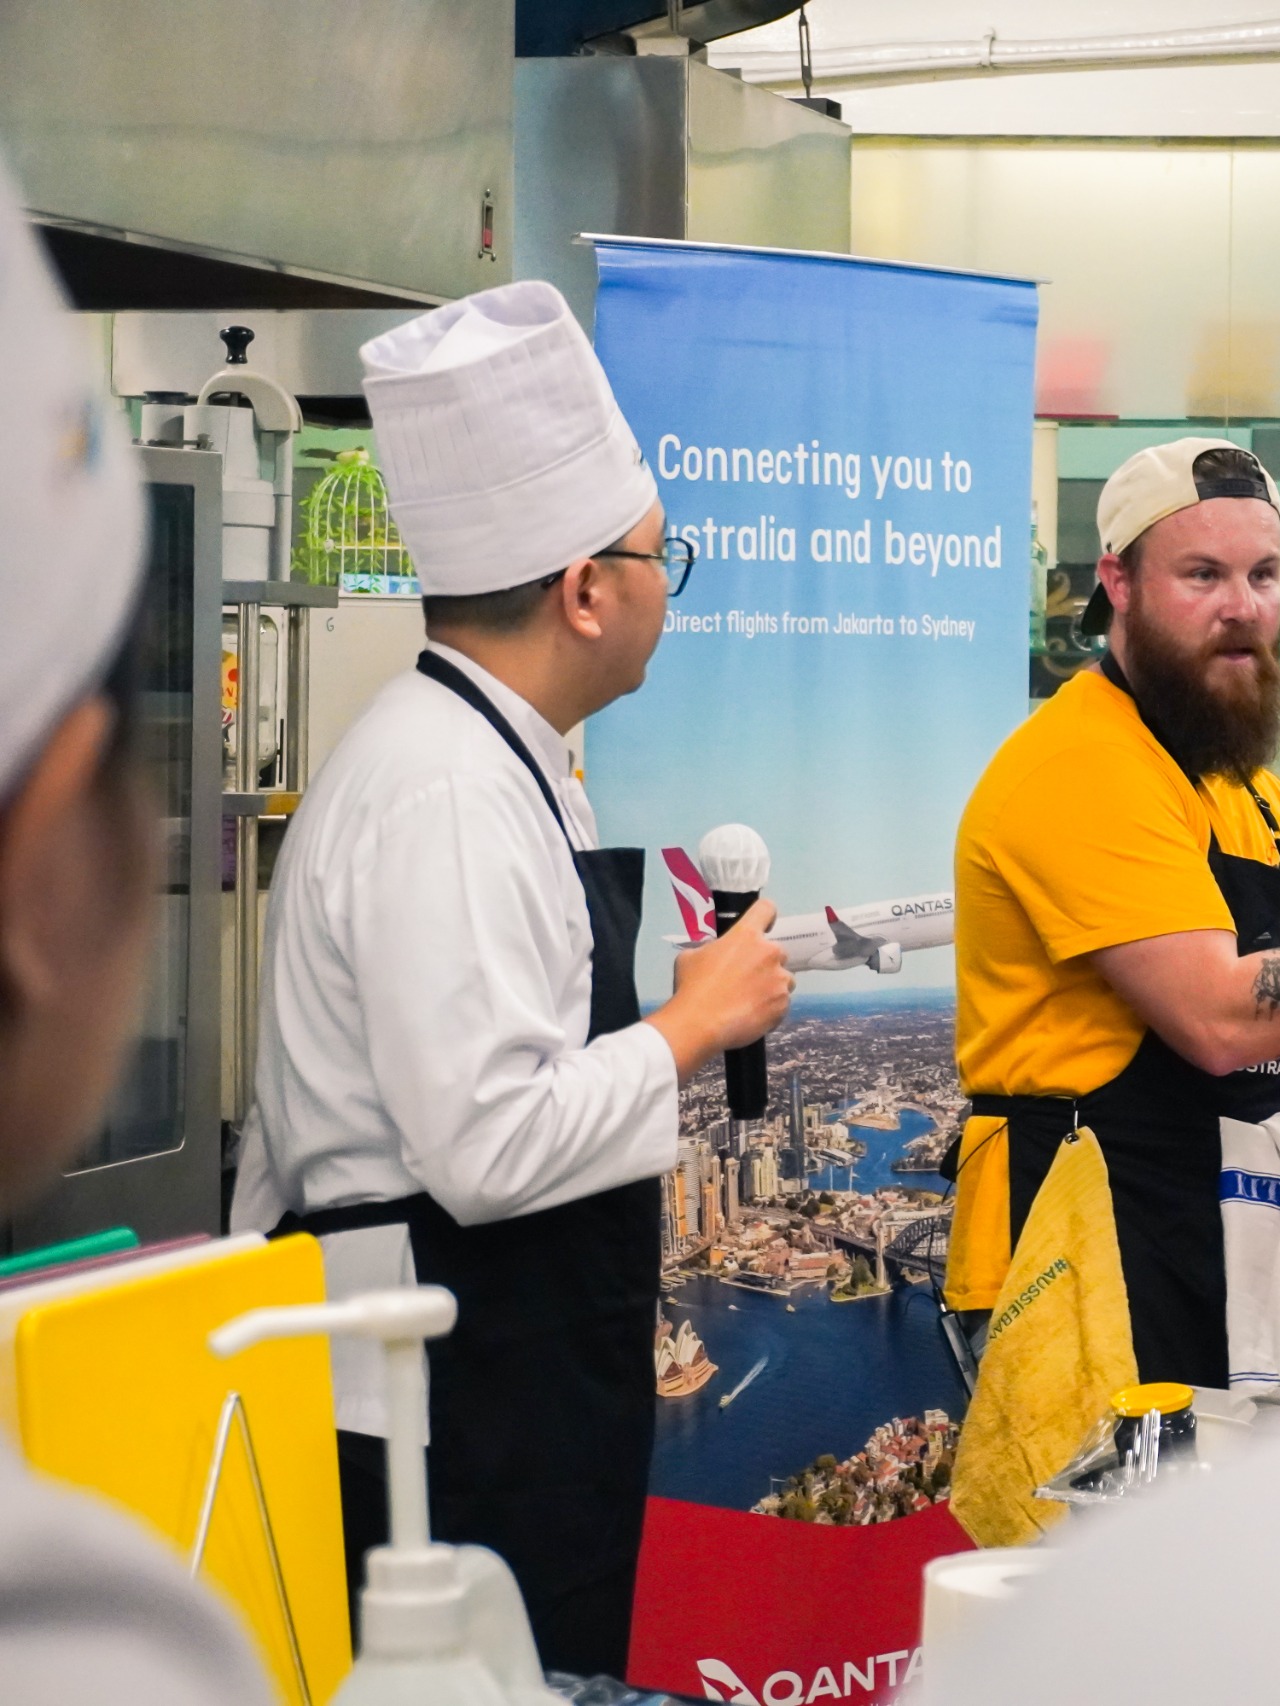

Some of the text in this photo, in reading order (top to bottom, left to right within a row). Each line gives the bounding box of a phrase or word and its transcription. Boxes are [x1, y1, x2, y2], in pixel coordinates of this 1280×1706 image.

[657, 433, 972, 500] Connecting you to
[811, 518, 872, 564] and
[884, 519, 1001, 577] beyond
[663, 609, 976, 642] Direct flights from Jakarta to Sydney
[891, 898, 953, 917] QANTAS
